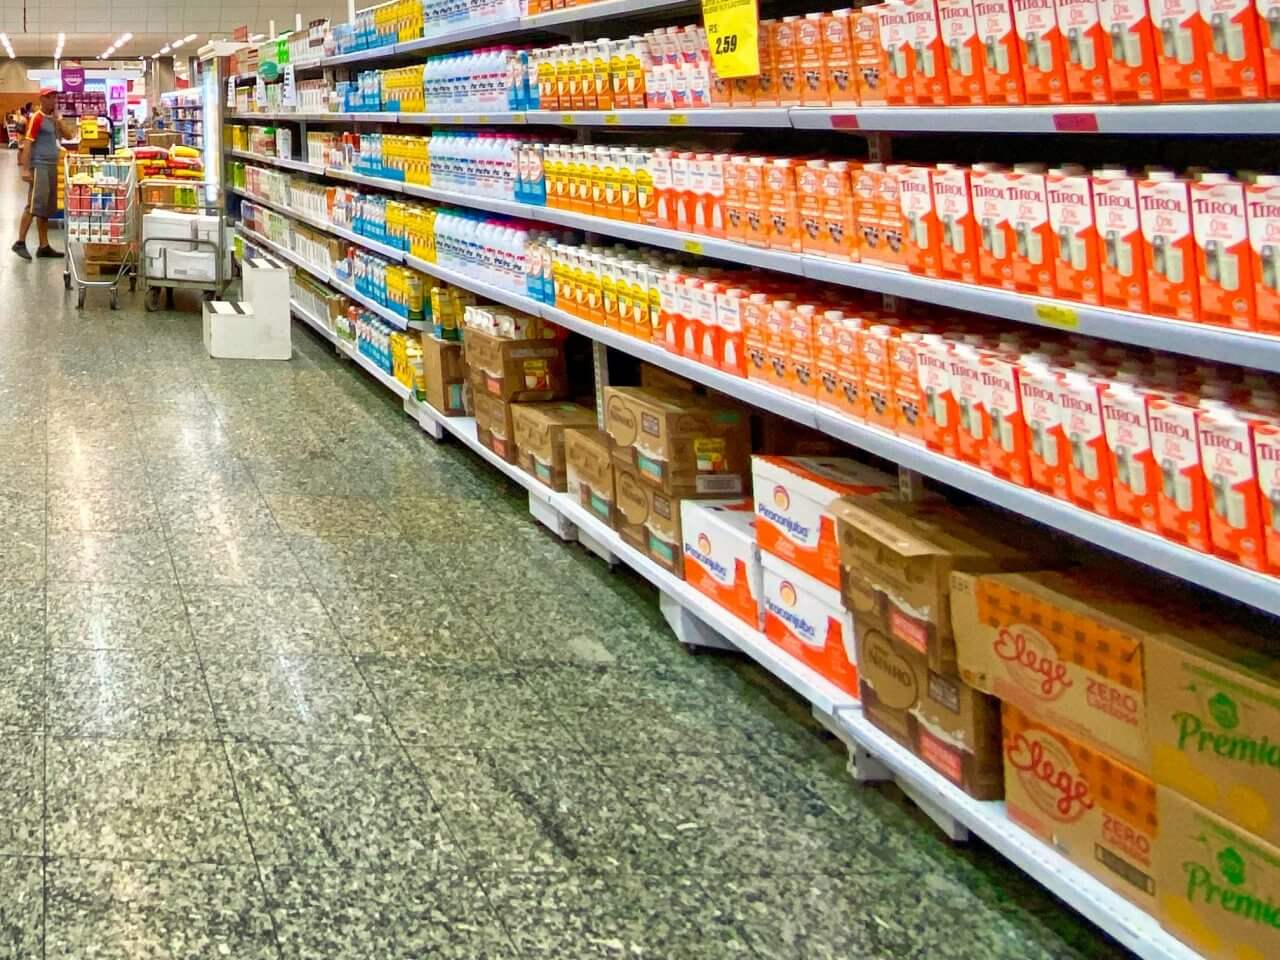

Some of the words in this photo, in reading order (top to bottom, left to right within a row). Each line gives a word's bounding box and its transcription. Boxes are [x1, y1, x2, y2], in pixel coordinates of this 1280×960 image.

[907, 10, 934, 25] TIROL
[940, 6, 972, 20] TIROL
[975, 2, 1008, 16] TIROL
[880, 13, 907, 27] TIROL
[715, 34, 738, 55] 2,59
[901, 181, 929, 194] TIROL
[935, 182, 967, 196] TIROL
[973, 184, 1005, 199] TIROL
[1006, 187, 1043, 203] TIROL
[1048, 189, 1088, 206] TIROL
[1096, 192, 1135, 210] TIROL
[1141, 195, 1186, 213] TIROL
[1193, 199, 1243, 217] TIROL
[1249, 201, 1280, 219] TIR
[981, 372, 1012, 393] TIROL
[1022, 382, 1059, 405] TIROL
[1060, 393, 1097, 415] TIROL
[1104, 405, 1146, 428] TIROL
[1150, 416, 1195, 441] TIROL
[1200, 430, 1249, 456] TIROL
[1086, 677, 1137, 713] ZERO
[1171, 711, 1280, 769] Premiu
[1102, 813, 1150, 854] ZERO
